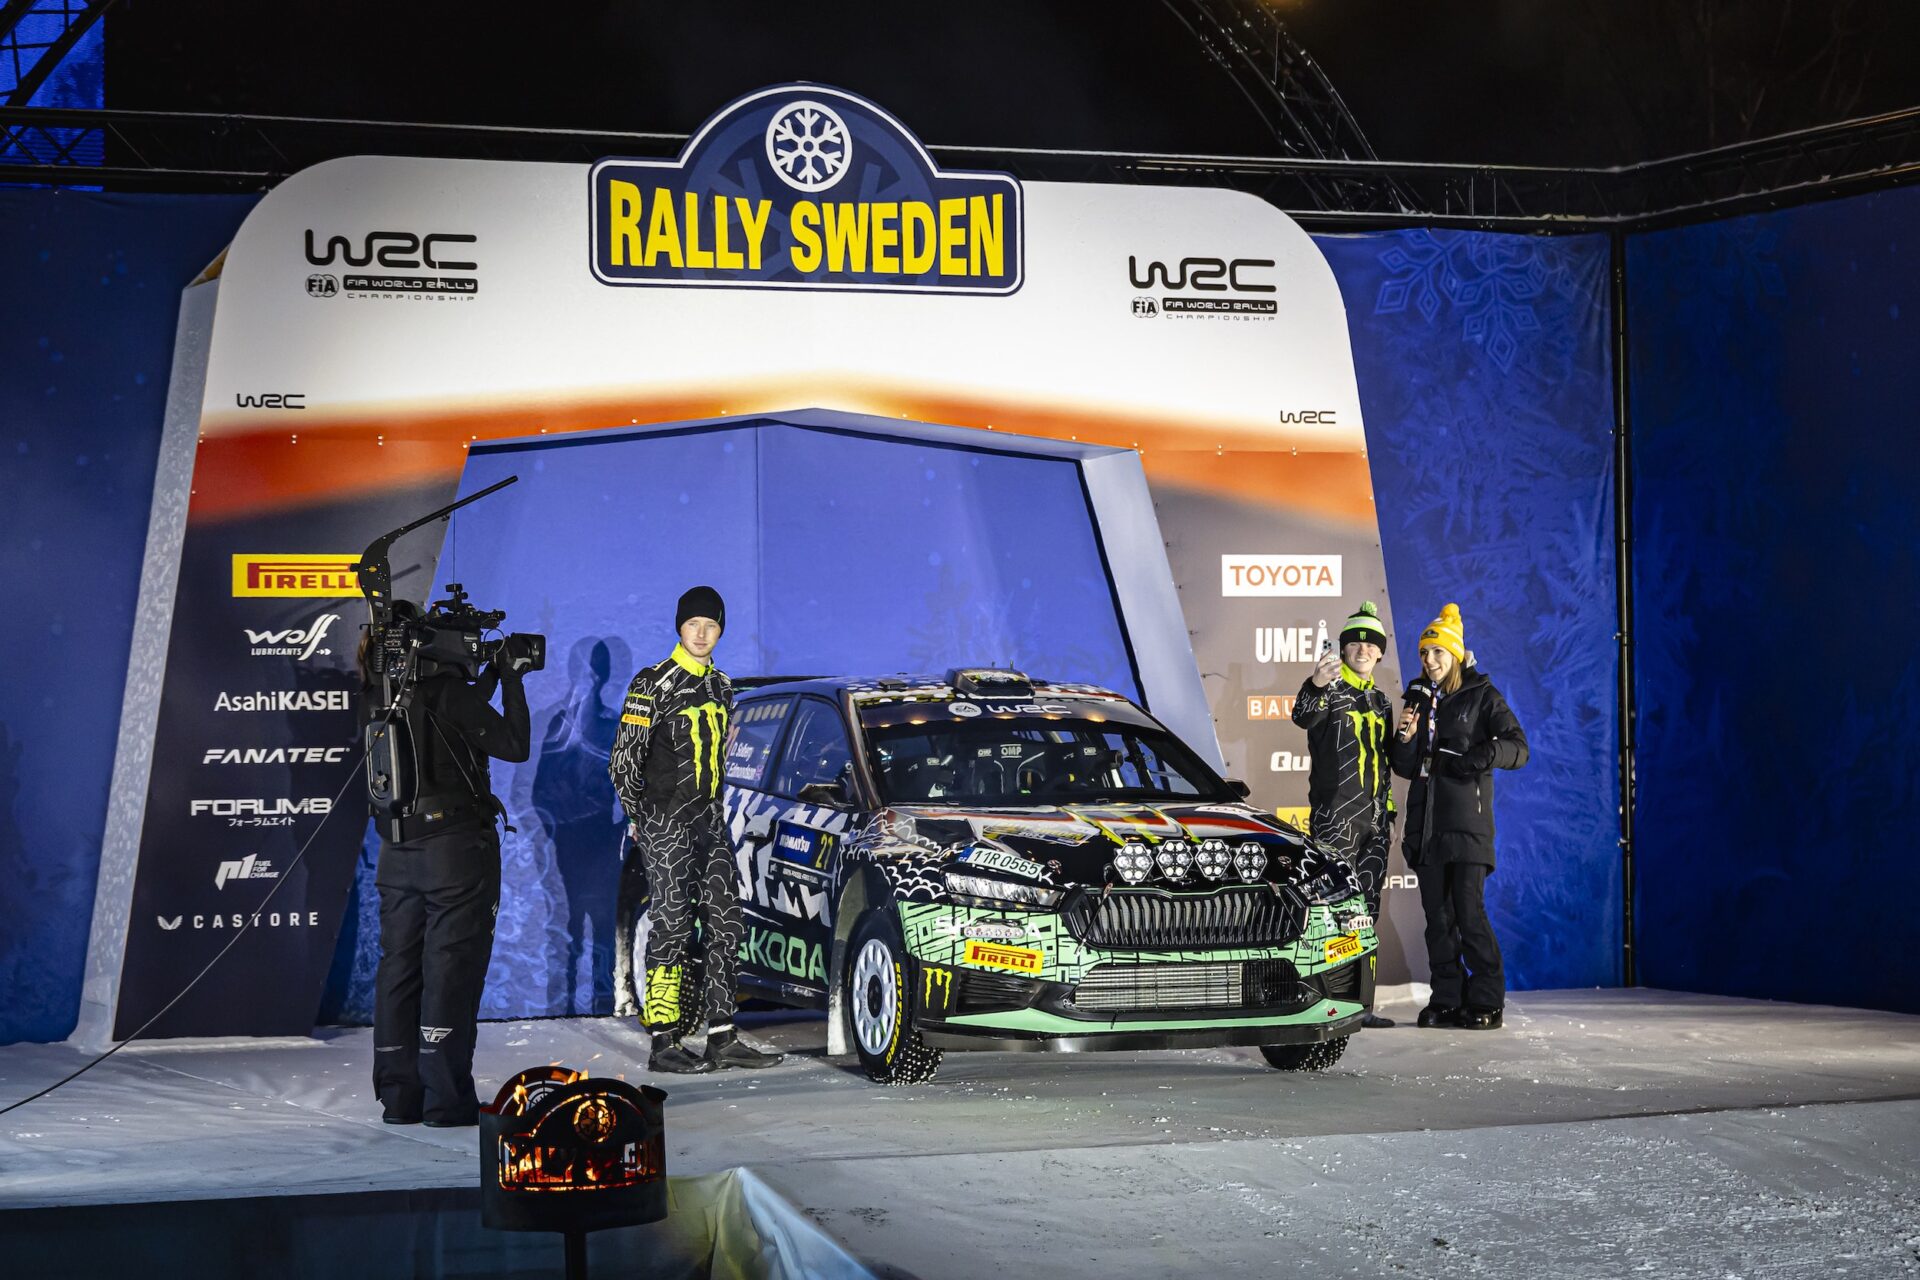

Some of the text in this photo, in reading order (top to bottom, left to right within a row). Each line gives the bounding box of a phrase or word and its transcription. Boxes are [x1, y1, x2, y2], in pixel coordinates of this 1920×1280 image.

[610, 179, 1004, 276] RALLY SWEDEN
[305, 229, 478, 270] WRC
[1129, 255, 1277, 293] WRC
[346, 279, 475, 290] FIA WORLD RALLY
[347, 293, 475, 301] CHAMPIONSHIP
[1187, 301, 1230, 310] WORLD
[1233, 302, 1275, 311] RALLY
[236, 393, 305, 409] WRC
[1280, 410, 1336, 424] WRC
[1230, 565, 1334, 586] TOYOTA
[472, 642, 478, 652] 9
[1255, 619, 1329, 664] UMEÅ
[251, 648, 302, 656] LUBRICANTS
[986, 704, 1073, 715] WRC
[1250, 699, 1297, 717] BAU
[203, 747, 347, 764] FANATEC
[1001, 747, 1022, 756] OMP
[1270, 751, 1311, 772] Qu
[190, 798, 332, 816] FORUM8
[228, 818, 296, 827] フォーラムエイト
[974, 850, 1040, 876] 11R 0565
[250, 871, 279, 879] CHANGE
[193, 912, 319, 929] CASTORE
[935, 916, 1043, 940] SKA
[972, 946, 1037, 969] PIRELLI
